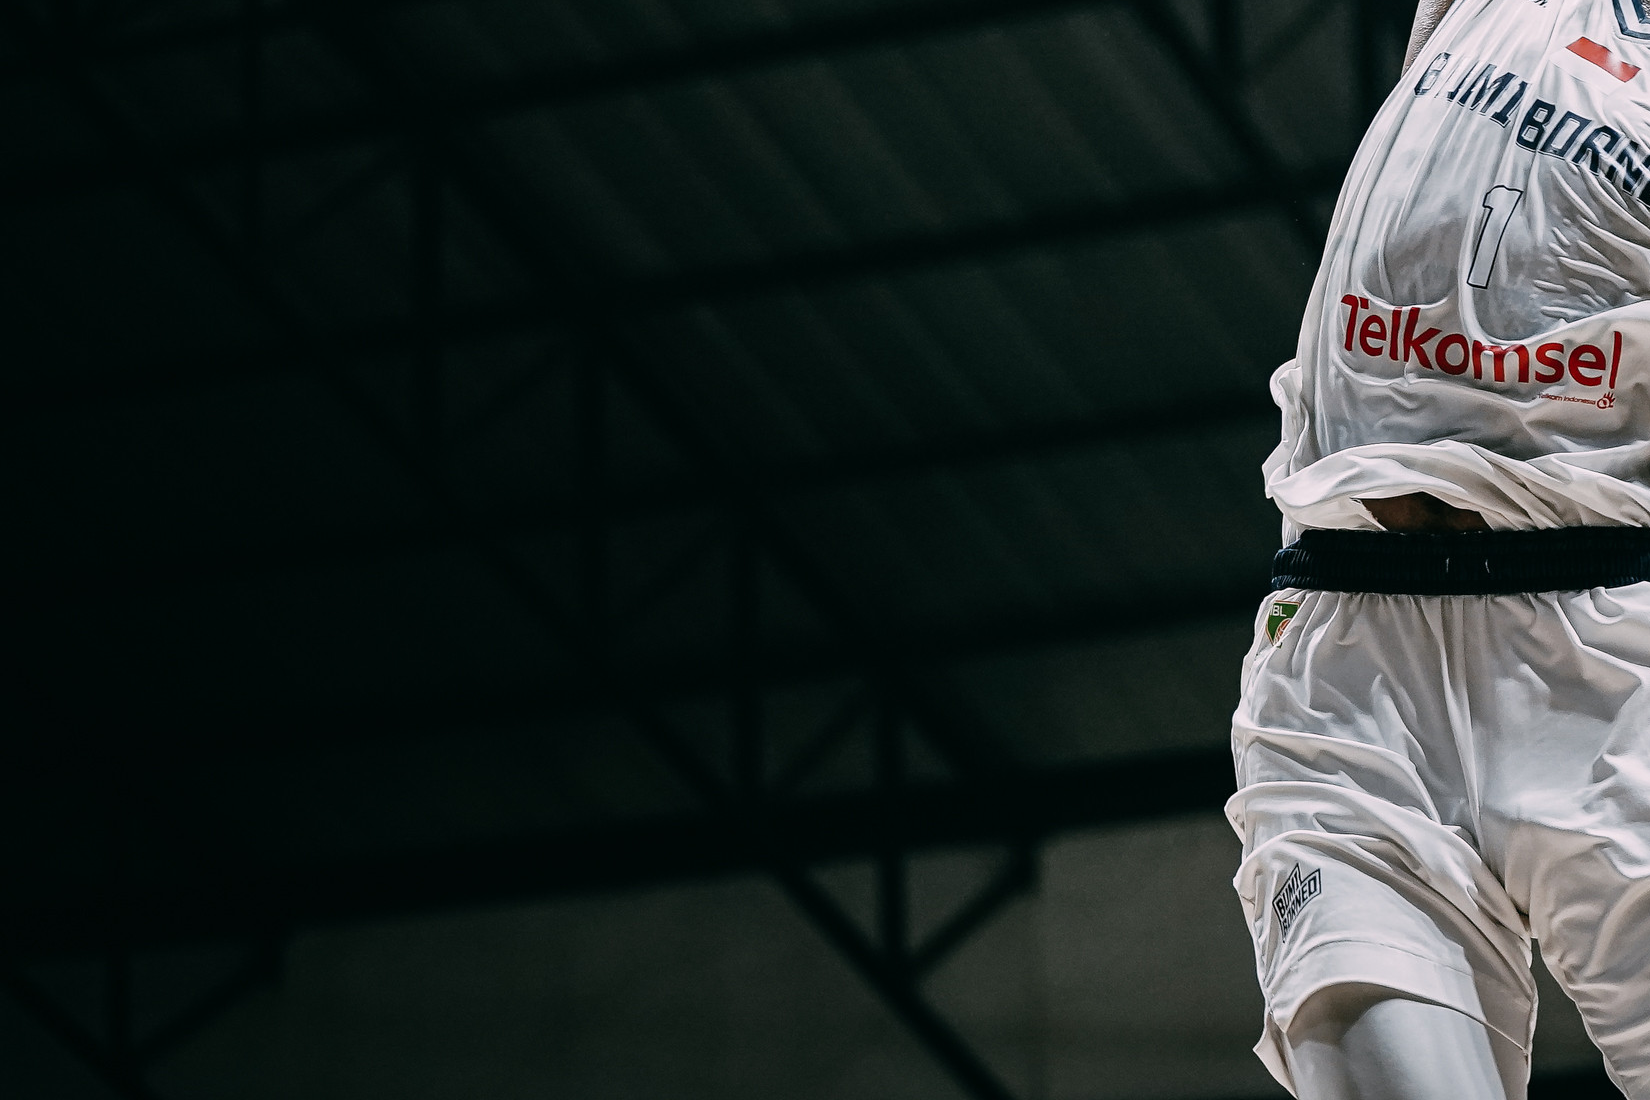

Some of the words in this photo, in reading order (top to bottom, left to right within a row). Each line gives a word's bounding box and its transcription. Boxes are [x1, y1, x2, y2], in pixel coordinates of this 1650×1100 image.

[1467, 185, 1524, 289] 1
[1341, 294, 1622, 389] Telkomsel
[1276, 871, 1299, 918] BUMI
